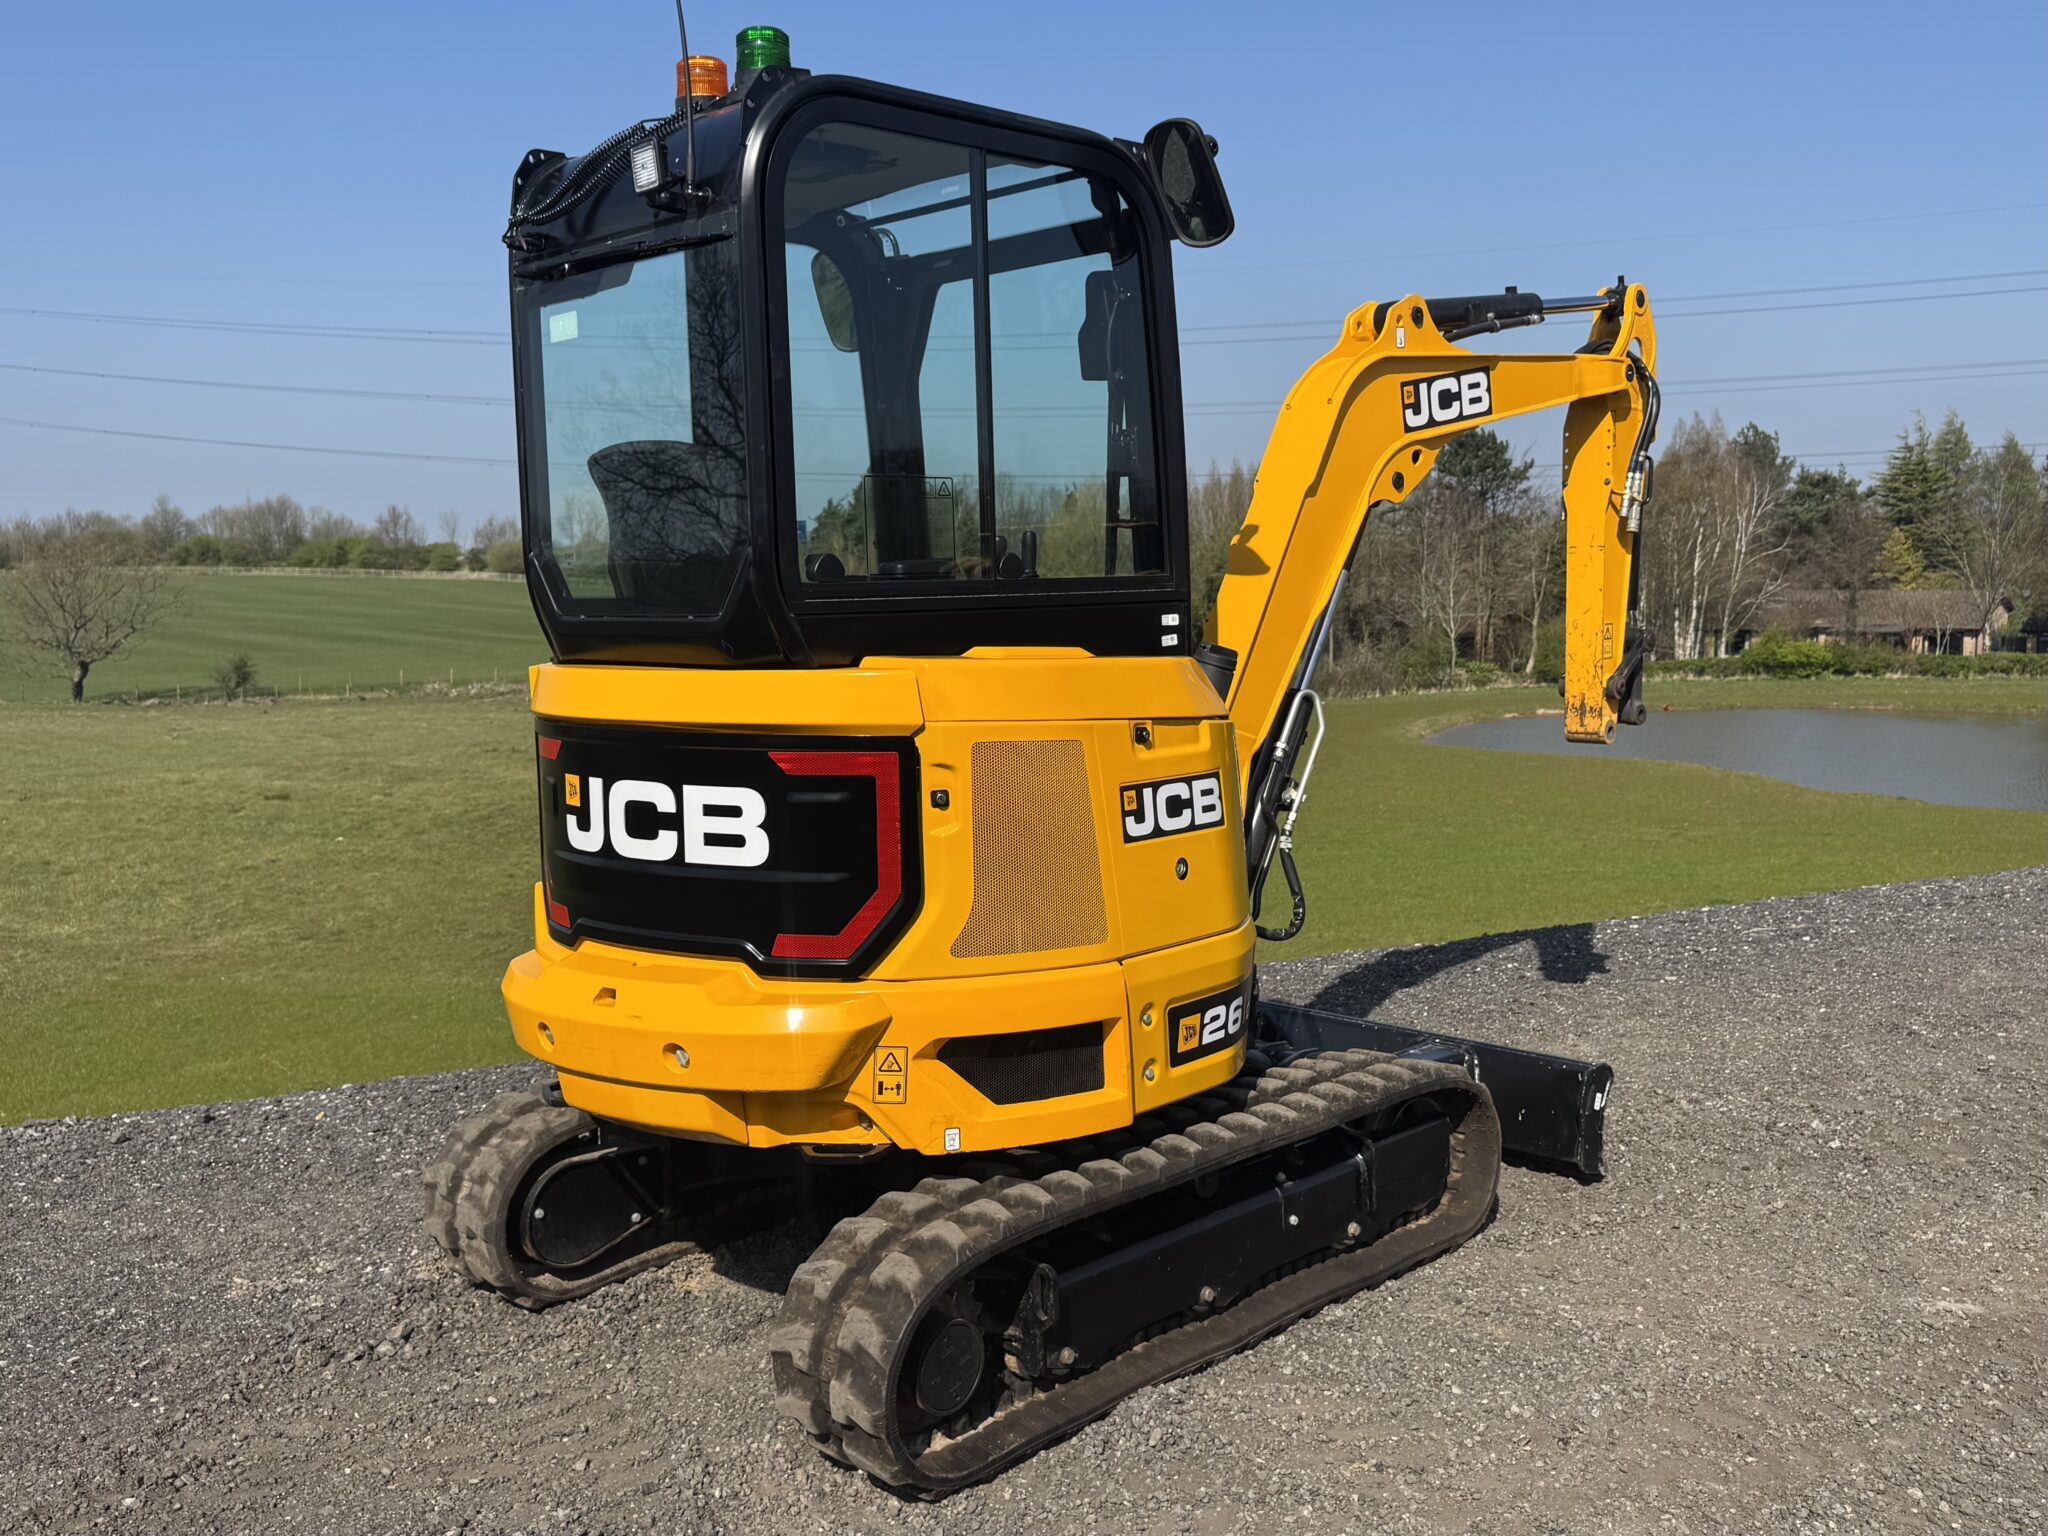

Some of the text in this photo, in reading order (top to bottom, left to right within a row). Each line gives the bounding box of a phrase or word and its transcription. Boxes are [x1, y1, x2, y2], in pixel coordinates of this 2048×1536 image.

[1405, 372, 1490, 428] JCB
[566, 777, 770, 867] JCB
[1125, 777, 1222, 837] JCB
